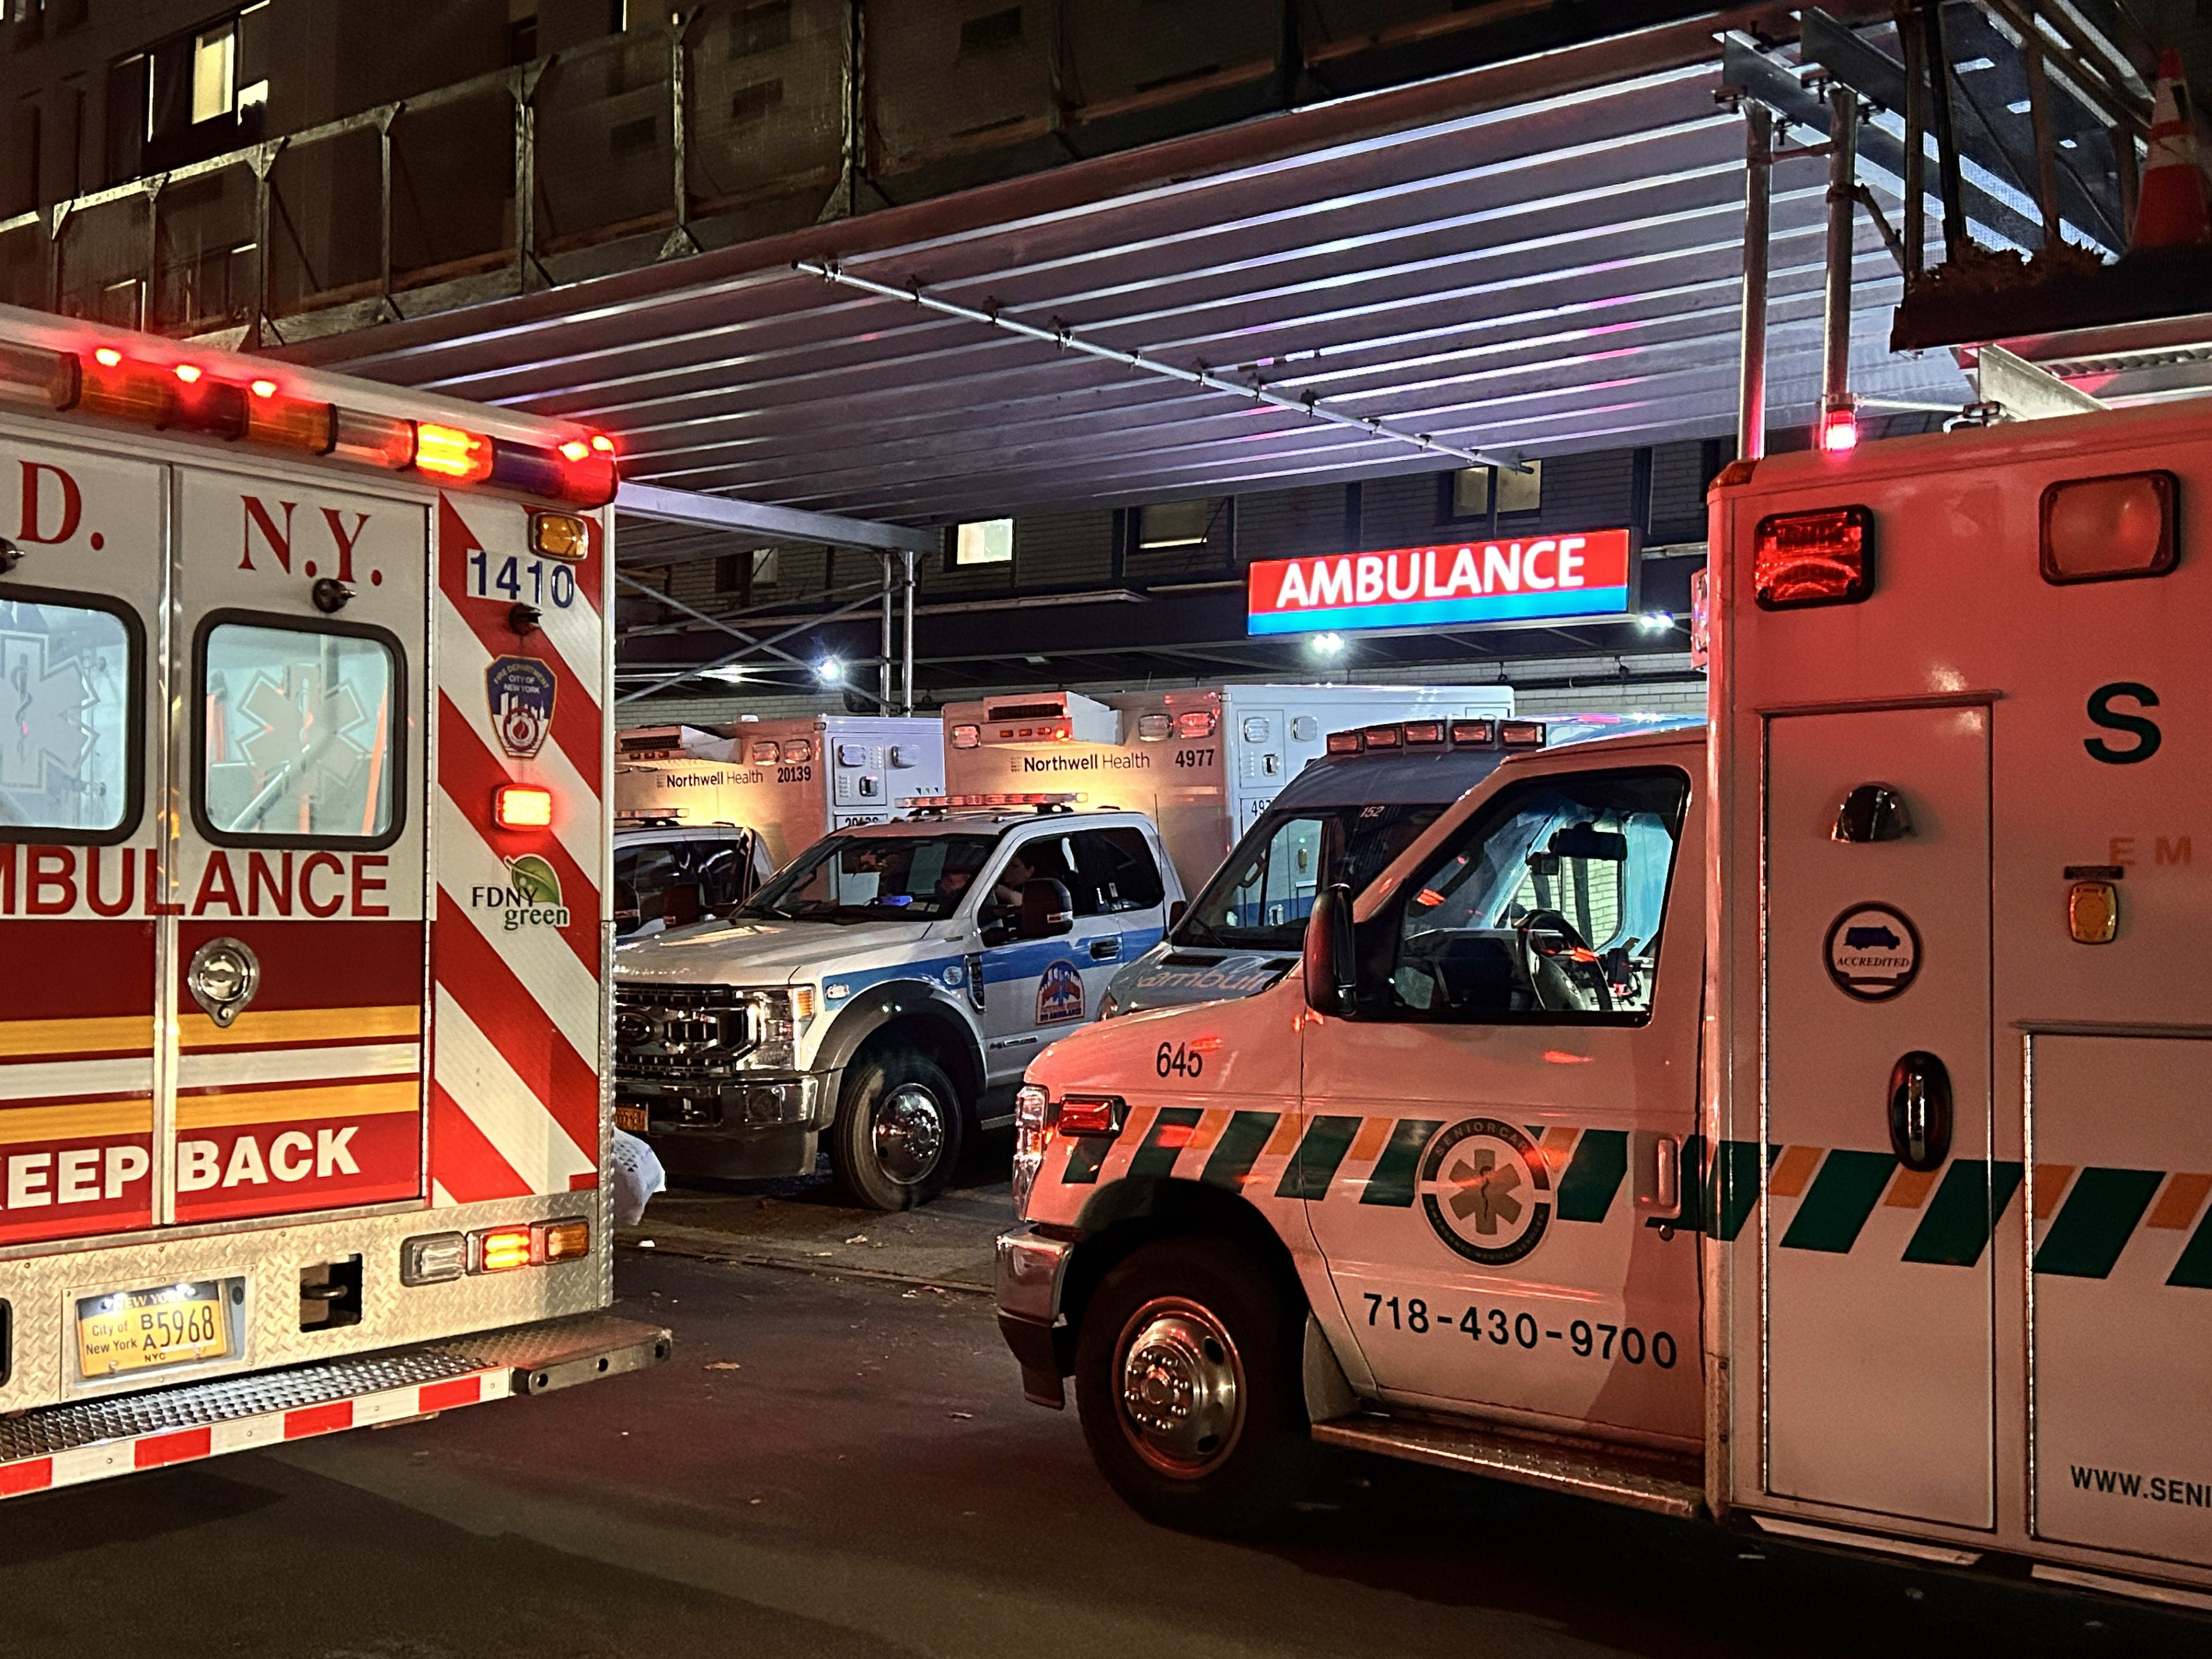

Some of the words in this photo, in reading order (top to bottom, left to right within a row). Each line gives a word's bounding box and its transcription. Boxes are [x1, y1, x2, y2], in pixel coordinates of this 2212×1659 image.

[16, 460, 104, 551] D.
[238, 494, 382, 586] N.Y.
[469, 551, 574, 608] 1410
[1275, 537, 1586, 608] AMBULANCE
[503, 683, 520, 692] NEW
[521, 685, 540, 694] YORK
[509, 674, 525, 683] CITY
[525, 676, 535, 684] OF
[2084, 681, 2162, 765] S
[1024, 753, 1098, 772] Northwell
[1103, 751, 1150, 770] Health
[1175, 748, 1215, 768] 4977
[666, 771, 724, 788] Northwell
[726, 769, 763, 784] Health
[777, 766, 812, 783] 20139
[1359, 806, 1385, 818] 152
[472, 887, 538, 907] FDNY
[504, 908, 568, 931] green
[1837, 956, 1910, 967] ACCREDITED
[1156, 1041, 1203, 1078] 645
[1435, 1122, 1532, 1158] SENIORCAR
[0, 1145, 150, 1210] EEP
[177, 1126, 361, 1192] BACK
[92, 1324, 113, 1336] City
[118, 1320, 128, 1333] of
[157, 1305, 215, 1348] 5968
[1363, 1291, 1677, 1369] 718-430-9700
[86, 1343, 110, 1355] New
[113, 1338, 137, 1351] York
[144, 1352, 166, 1362] NYC
